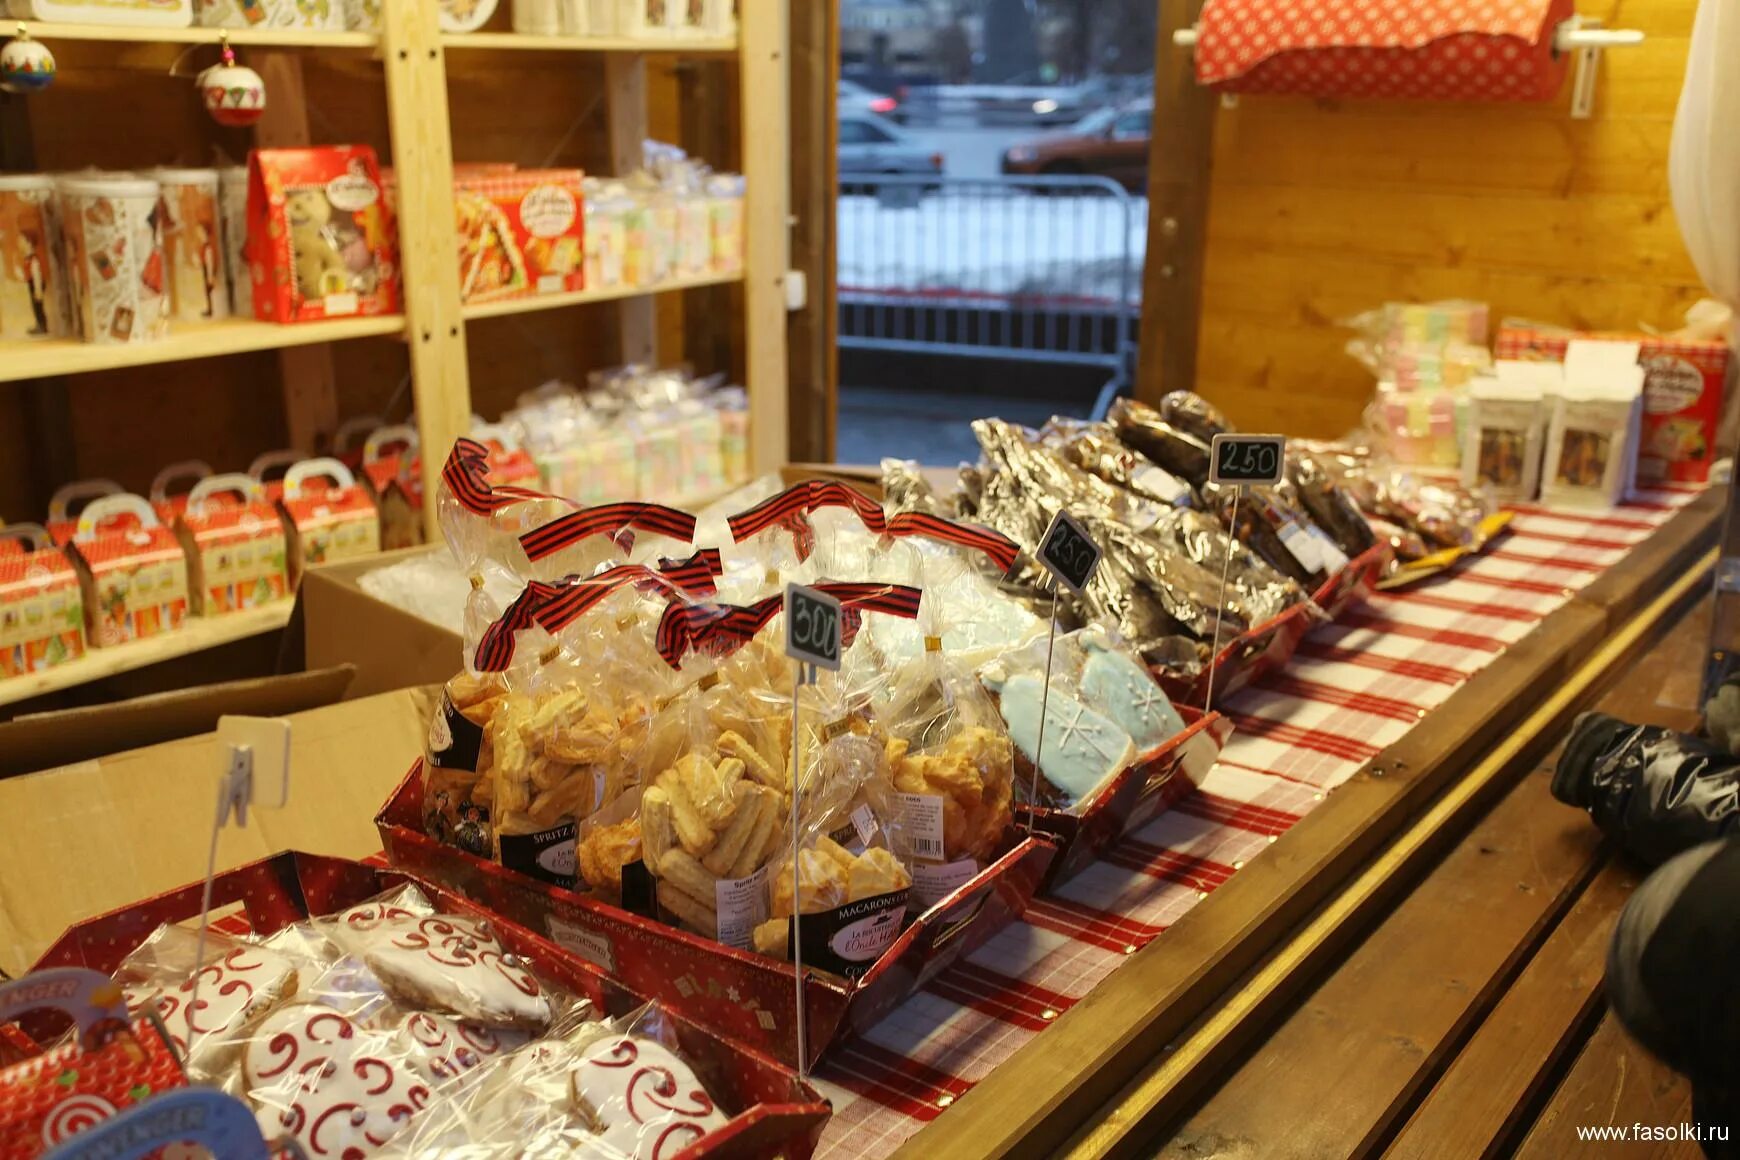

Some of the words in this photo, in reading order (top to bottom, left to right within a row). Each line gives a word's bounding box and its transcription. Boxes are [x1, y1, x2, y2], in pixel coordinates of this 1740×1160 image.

[1222, 442, 1275, 473] 250
[1050, 524, 1091, 575] 250
[533, 826, 568, 843] SPRITZ
